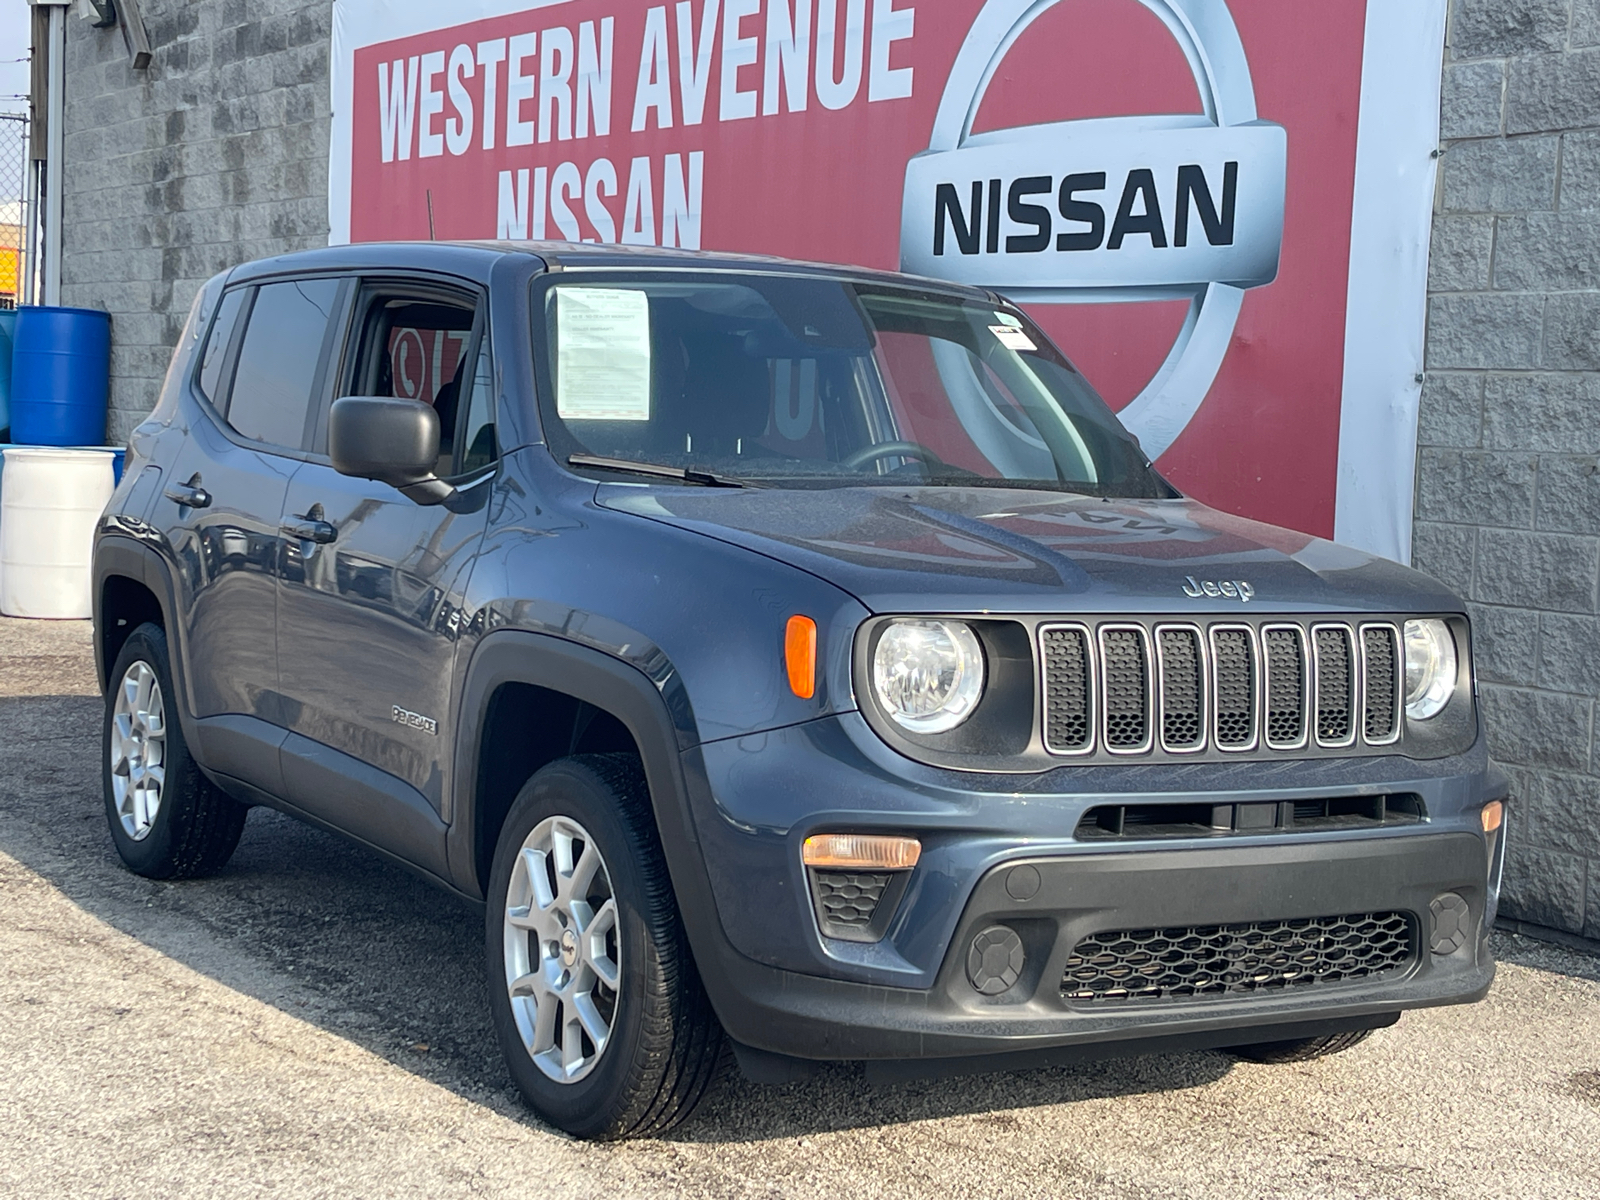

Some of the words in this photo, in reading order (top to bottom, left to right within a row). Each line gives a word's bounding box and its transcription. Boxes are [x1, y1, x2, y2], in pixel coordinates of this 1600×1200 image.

[377, 15, 615, 164] WESTERN
[630, 0, 916, 133] AVENUE
[497, 150, 705, 250] NISSAN
[933, 160, 1239, 256] NISSAN
[1181, 575, 1256, 603] Jeep
[391, 704, 438, 736] RENEGADE
